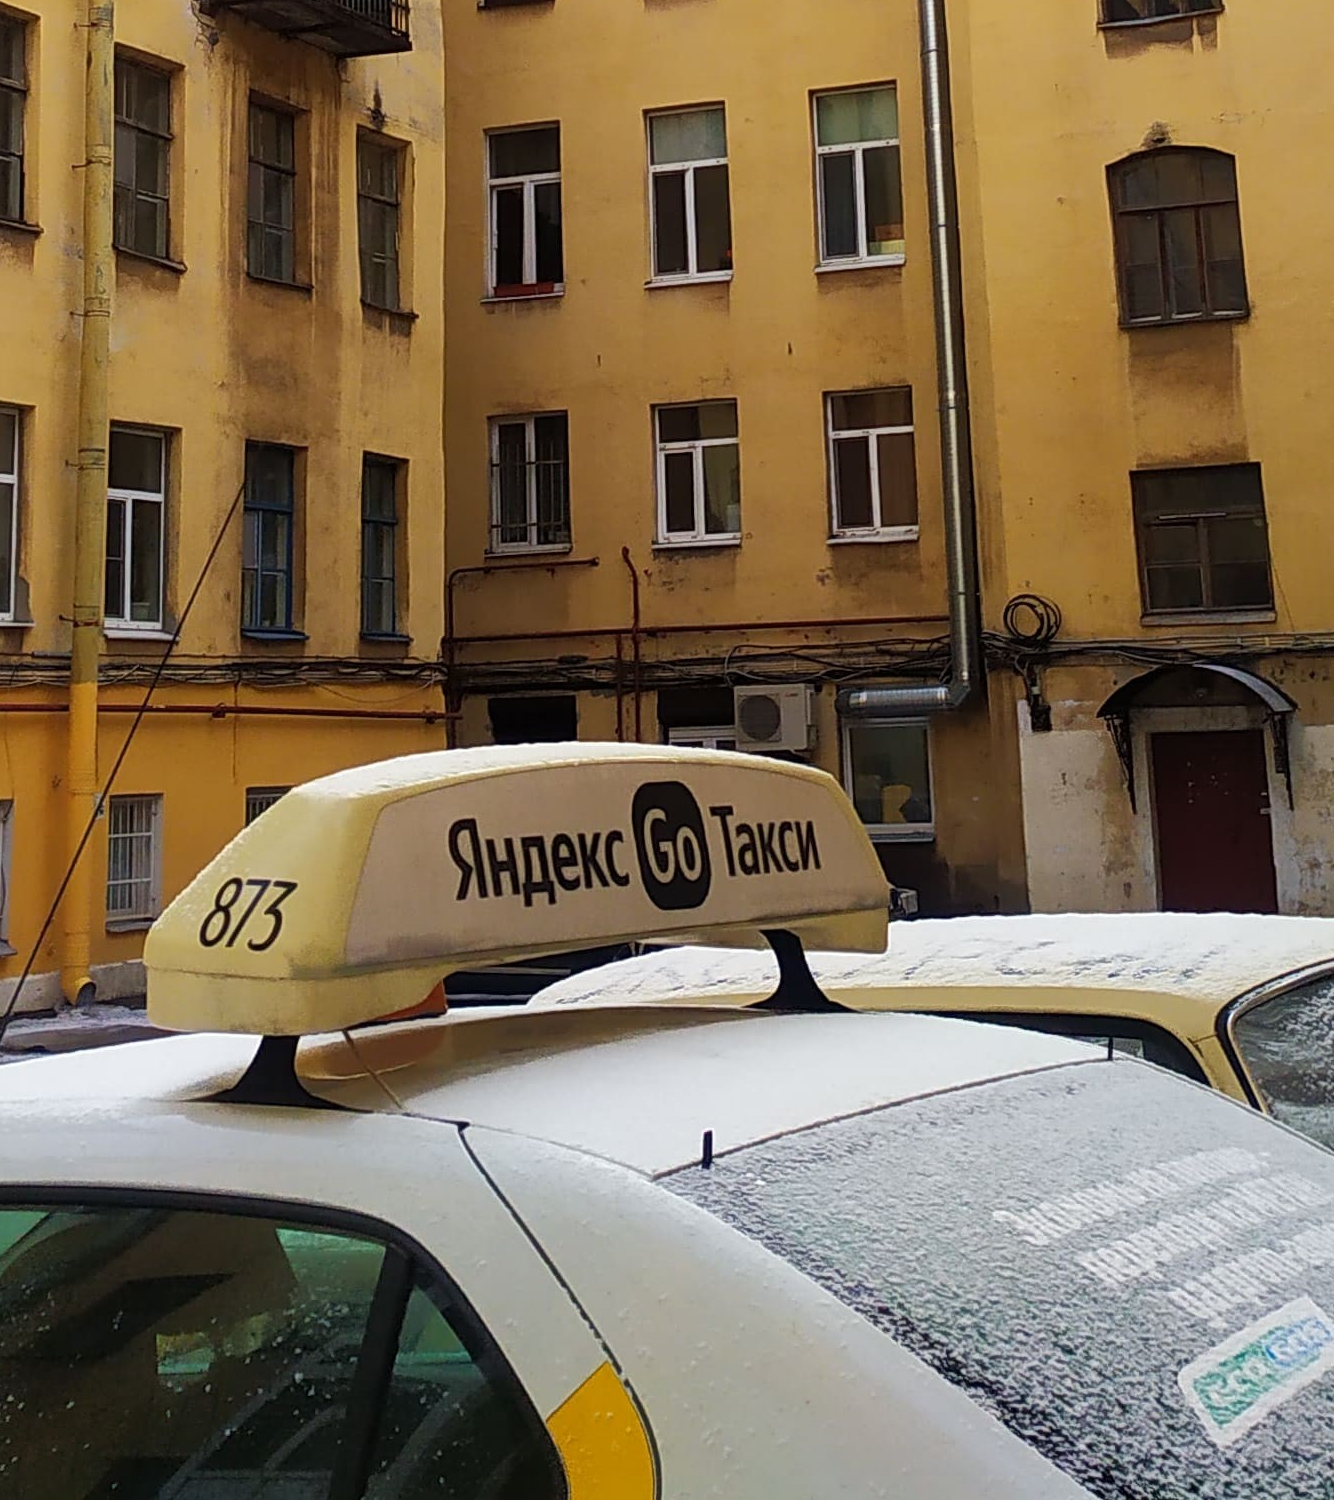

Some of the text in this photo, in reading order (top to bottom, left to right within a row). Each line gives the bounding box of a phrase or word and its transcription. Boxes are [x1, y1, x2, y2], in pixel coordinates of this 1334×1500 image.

[447, 805, 822, 907] Яндекс Go Такси
[199, 877, 298, 951] 873
